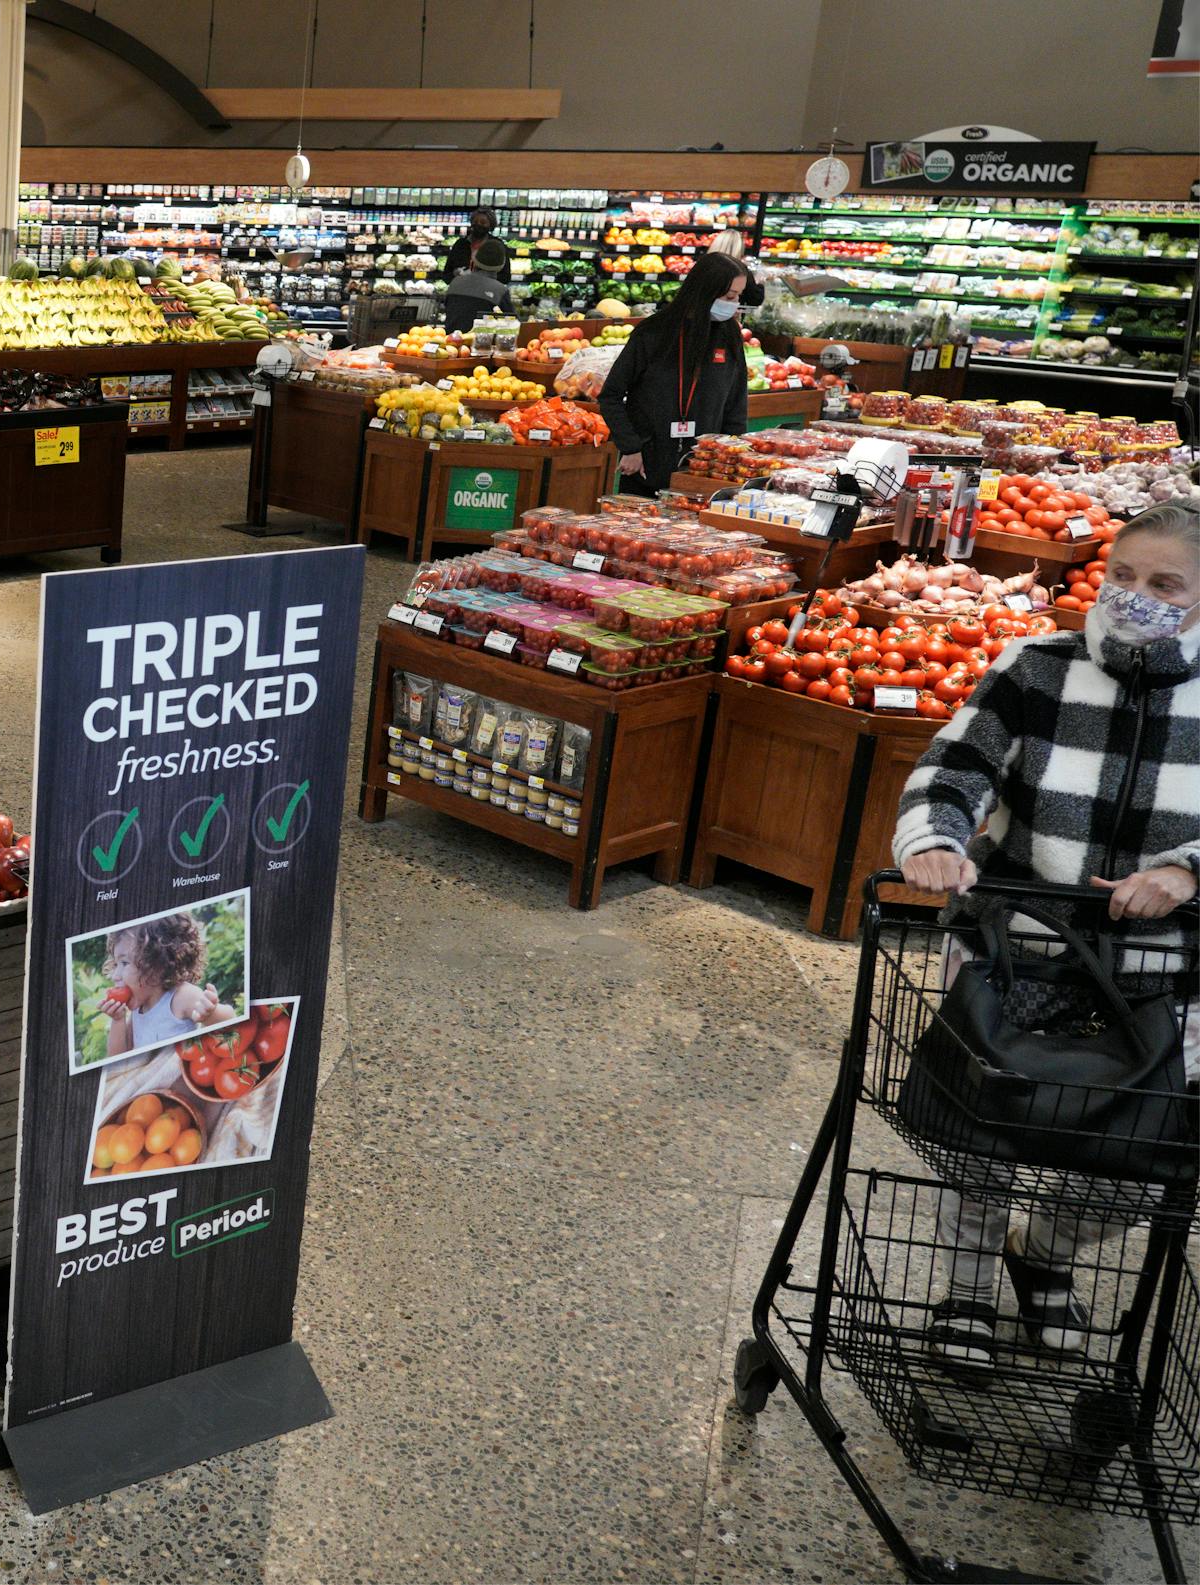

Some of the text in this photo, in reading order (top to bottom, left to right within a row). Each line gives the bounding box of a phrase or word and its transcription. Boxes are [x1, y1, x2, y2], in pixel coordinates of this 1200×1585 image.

[964, 151, 1007, 164] certified
[961, 163, 1075, 182] ORGANIC
[36, 428, 59, 441] Sale!
[453, 490, 509, 509] ORGANIC
[87, 604, 323, 689] TRIPLE
[83, 673, 318, 743] CHECKED
[108, 739, 280, 795] freshness.
[266, 859, 289, 872] Store
[172, 872, 221, 888] Warehouse
[96, 889, 119, 902] Field
[55, 1187, 178, 1254] BEST
[180, 1197, 270, 1248] Period.
[56, 1236, 166, 1288] produce
